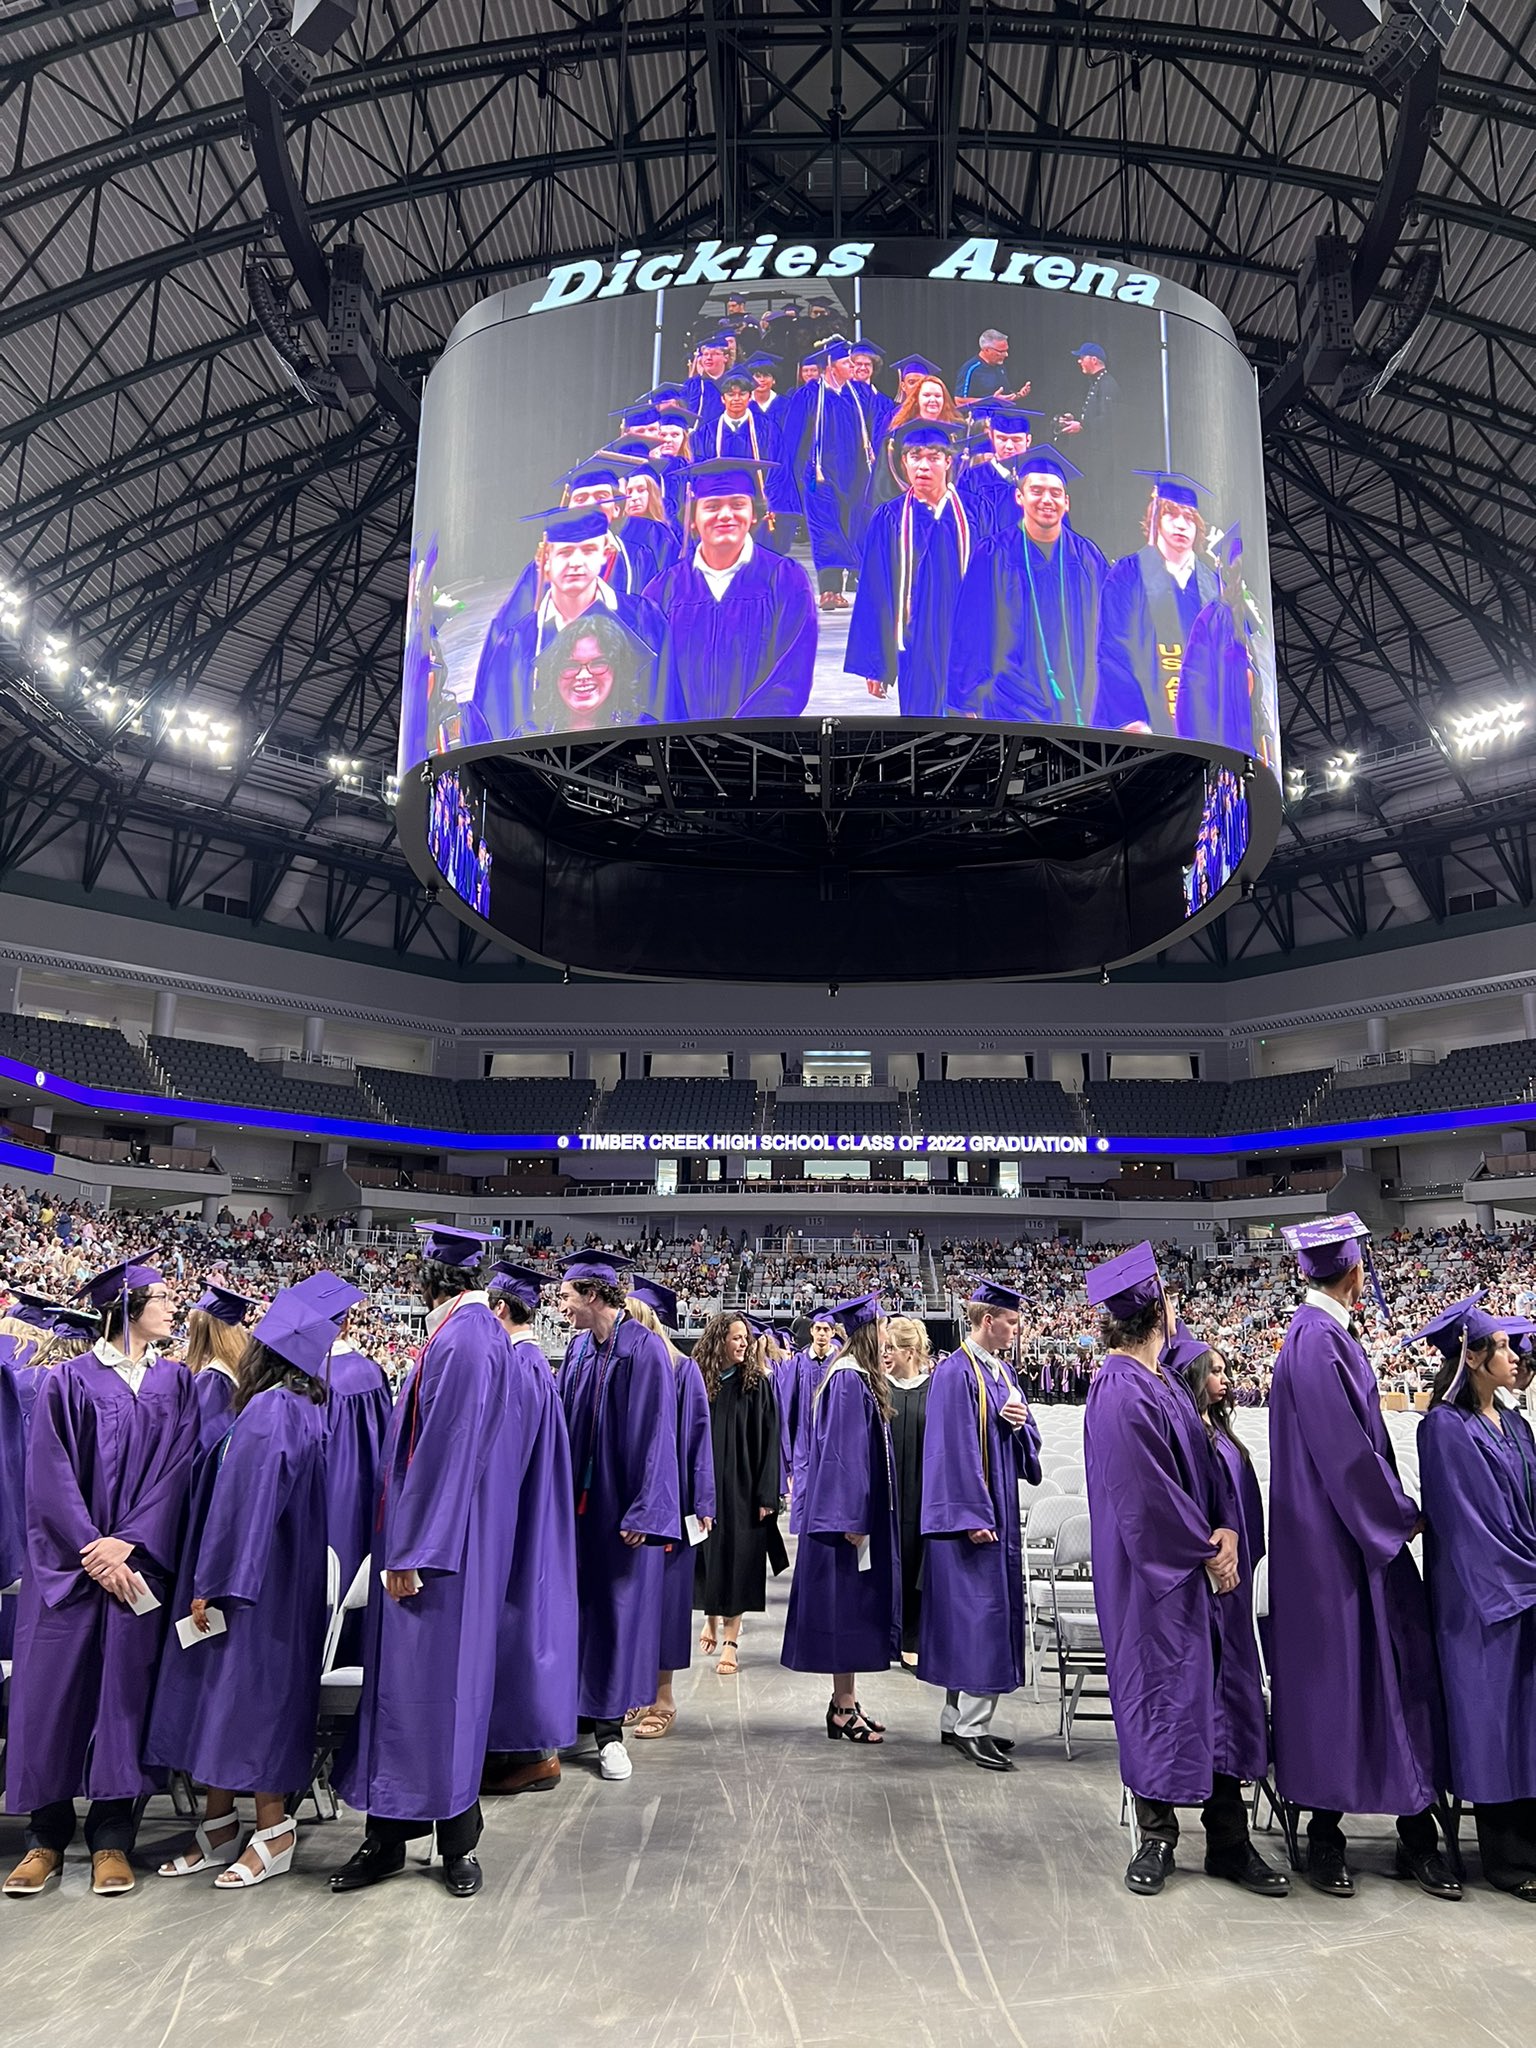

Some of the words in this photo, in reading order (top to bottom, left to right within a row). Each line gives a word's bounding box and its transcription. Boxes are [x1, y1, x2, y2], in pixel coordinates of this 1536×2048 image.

[528, 234, 875, 313] Dickies
[927, 237, 1162, 307] Arena
[681, 1041, 695, 1049] 214
[830, 1041, 844, 1049] 215
[980, 1041, 995, 1049] 216
[1231, 1040, 1244, 1049] 217
[579, 1134, 646, 1151] TIMBER
[649, 1134, 711, 1151] CREEK
[713, 1135, 757, 1151] HIGH
[760, 1135, 835, 1151] SCHOOL
[837, 1135, 895, 1152] CLASS
[898, 1136, 925, 1152] OF
[927, 1136, 966, 1152] 2022
[969, 1136, 1088, 1153] GRADUATION
[473, 1217, 487, 1225] 113
[620, 1217, 635, 1225] 114
[808, 1217, 823, 1225] 115
[1028, 1220, 1043, 1228] 116
[1196, 1222, 1211, 1230] 117
